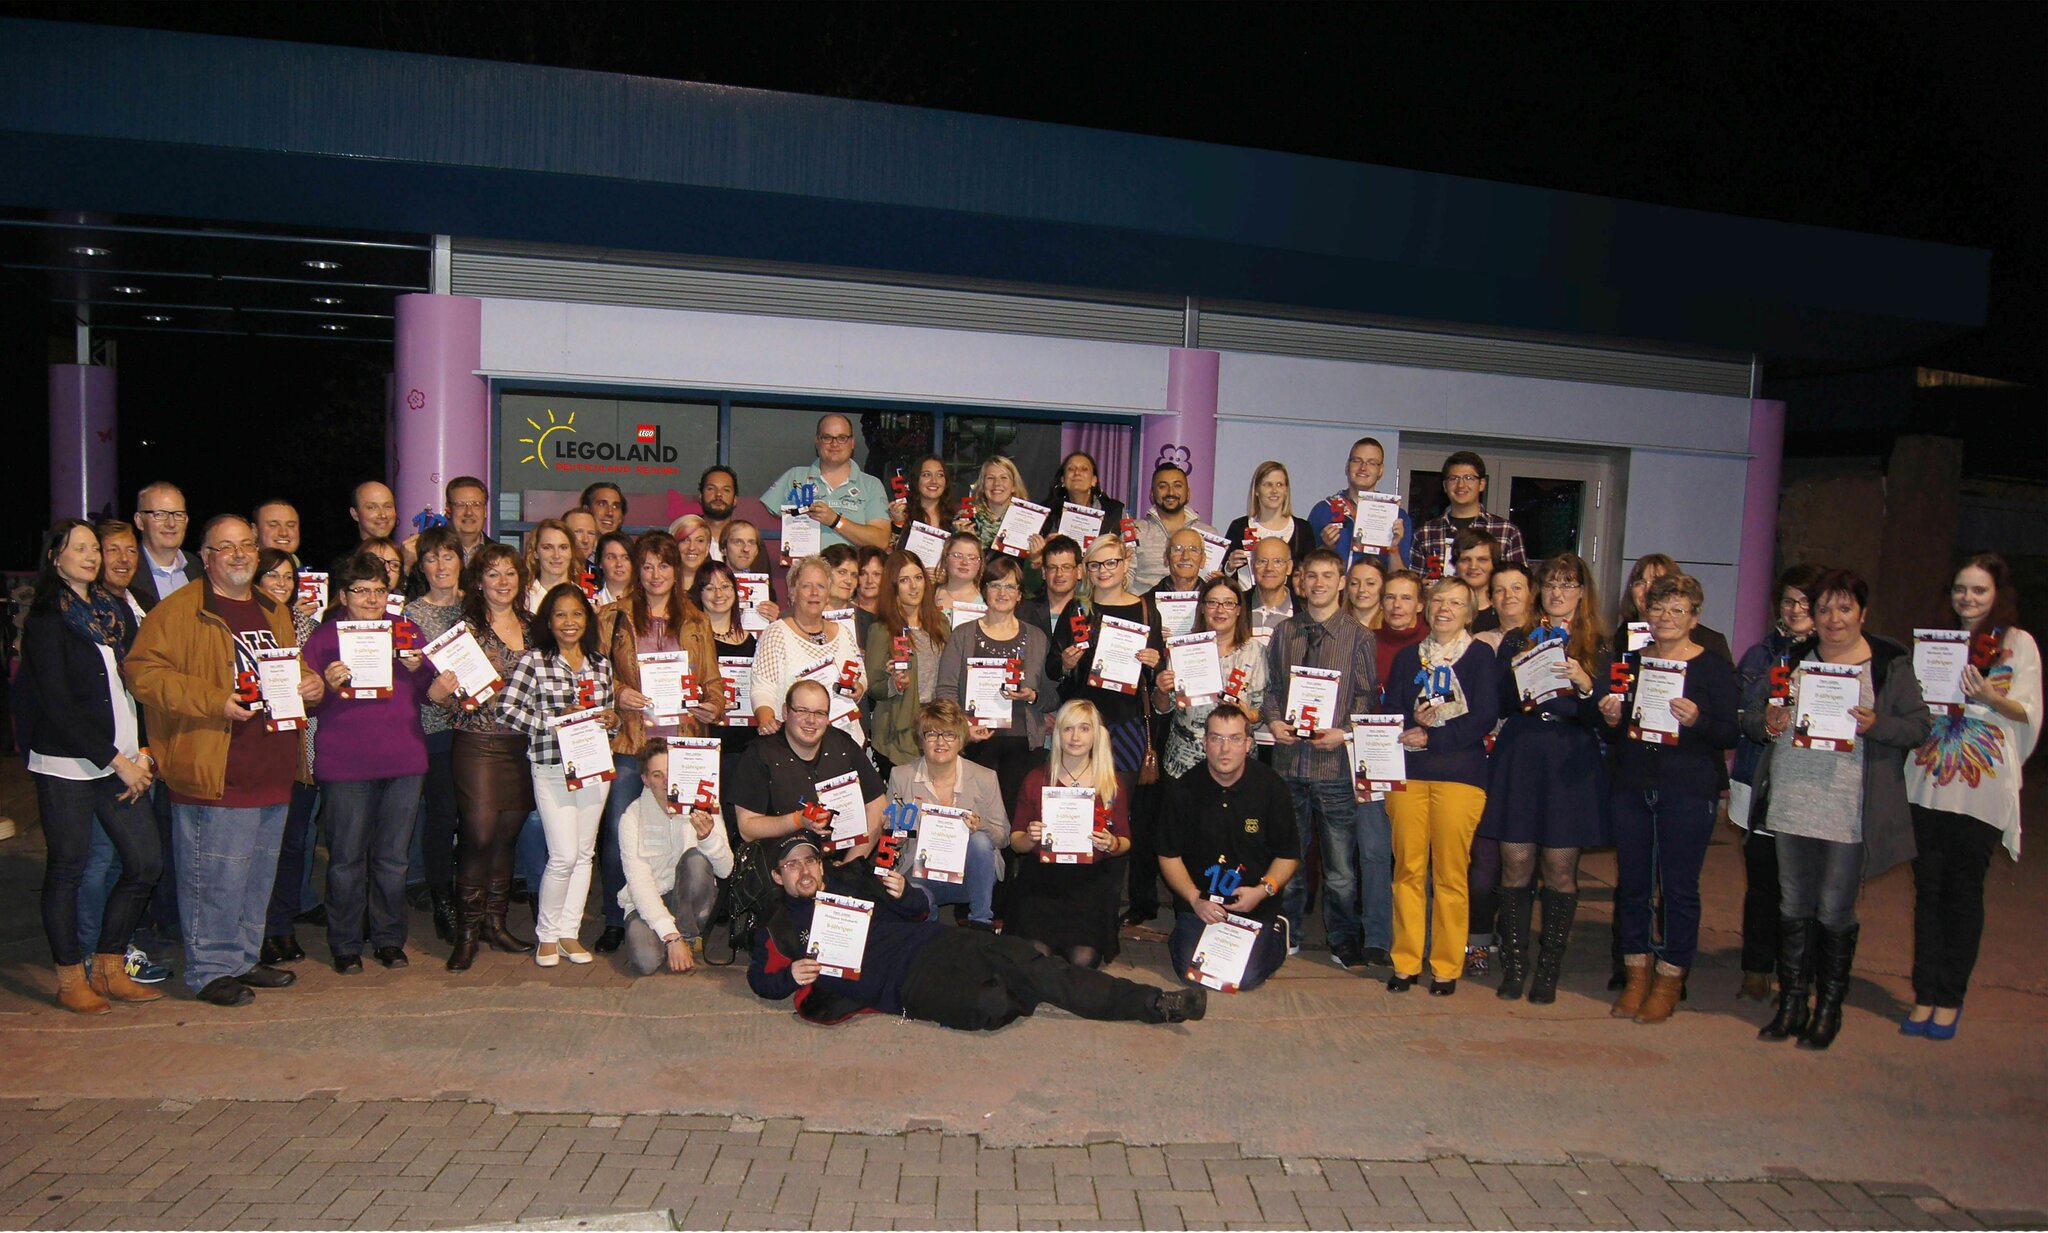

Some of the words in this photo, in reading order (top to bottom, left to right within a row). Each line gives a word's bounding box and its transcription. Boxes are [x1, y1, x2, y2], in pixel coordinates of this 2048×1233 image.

[555, 424, 679, 464] LEGOLAND
[638, 429, 654, 437] LEGO
[555, 462, 632, 474] DEUTSCHLAND
[635, 465, 681, 476] RESORT
[787, 483, 815, 508] 10
[891, 475, 907, 498] 5
[961, 497, 974, 518] 5
[1331, 499, 1345, 522] 5
[1427, 555, 1441, 578] 5
[580, 572, 596, 599] 5
[394, 620, 415, 650] 5
[1070, 614, 1089, 643] 5
[893, 636, 910, 661] 5
[1973, 633, 1998, 667] 5
[237, 669, 259, 701] 5
[840, 659, 859, 688] 5
[1004, 657, 1022, 685] 5
[1226, 668, 1246, 696] 5
[1413, 665, 1453, 698] 10
[1610, 661, 1630, 693] 5
[1770, 664, 1790, 697] 5
[681, 674, 700, 701] 5
[1300, 704, 1319, 731] 5
[695, 779, 715, 808] 5
[882, 802, 919, 831] 10
[876, 834, 897, 868] 5
[1203, 863, 1243, 898] 10
